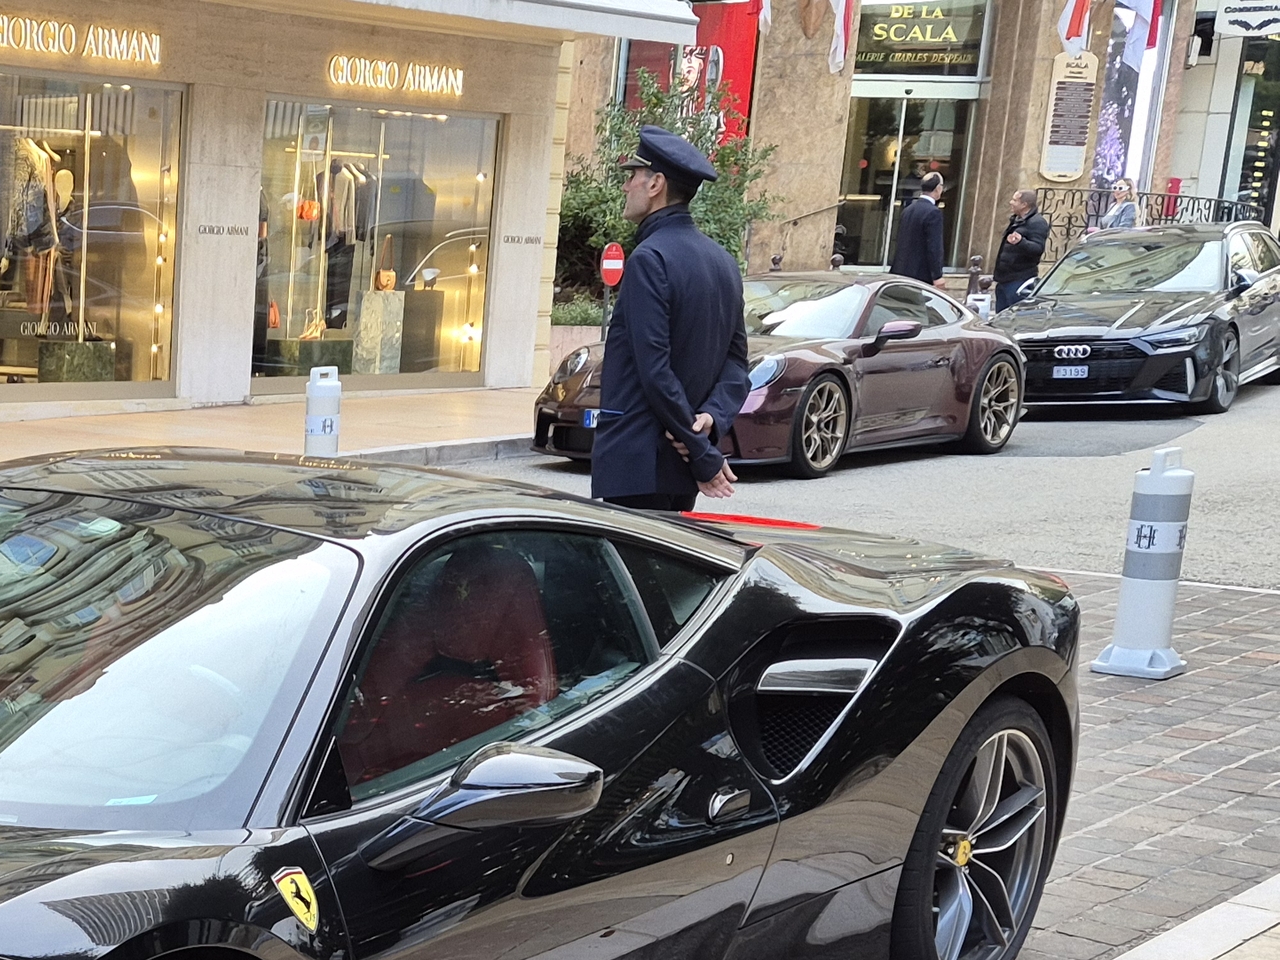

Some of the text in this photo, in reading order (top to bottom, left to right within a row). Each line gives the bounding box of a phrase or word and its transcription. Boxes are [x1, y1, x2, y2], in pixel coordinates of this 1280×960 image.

[889, 5, 945, 19] DE LA
[872, 22, 959, 42] SCALA
[82, 24, 161, 65] ARMANI
[888, 52, 929, 63] CHARLES
[329, 54, 464, 97] GIORGIO ARMANI
[1062, 367, 1087, 377] 3199
